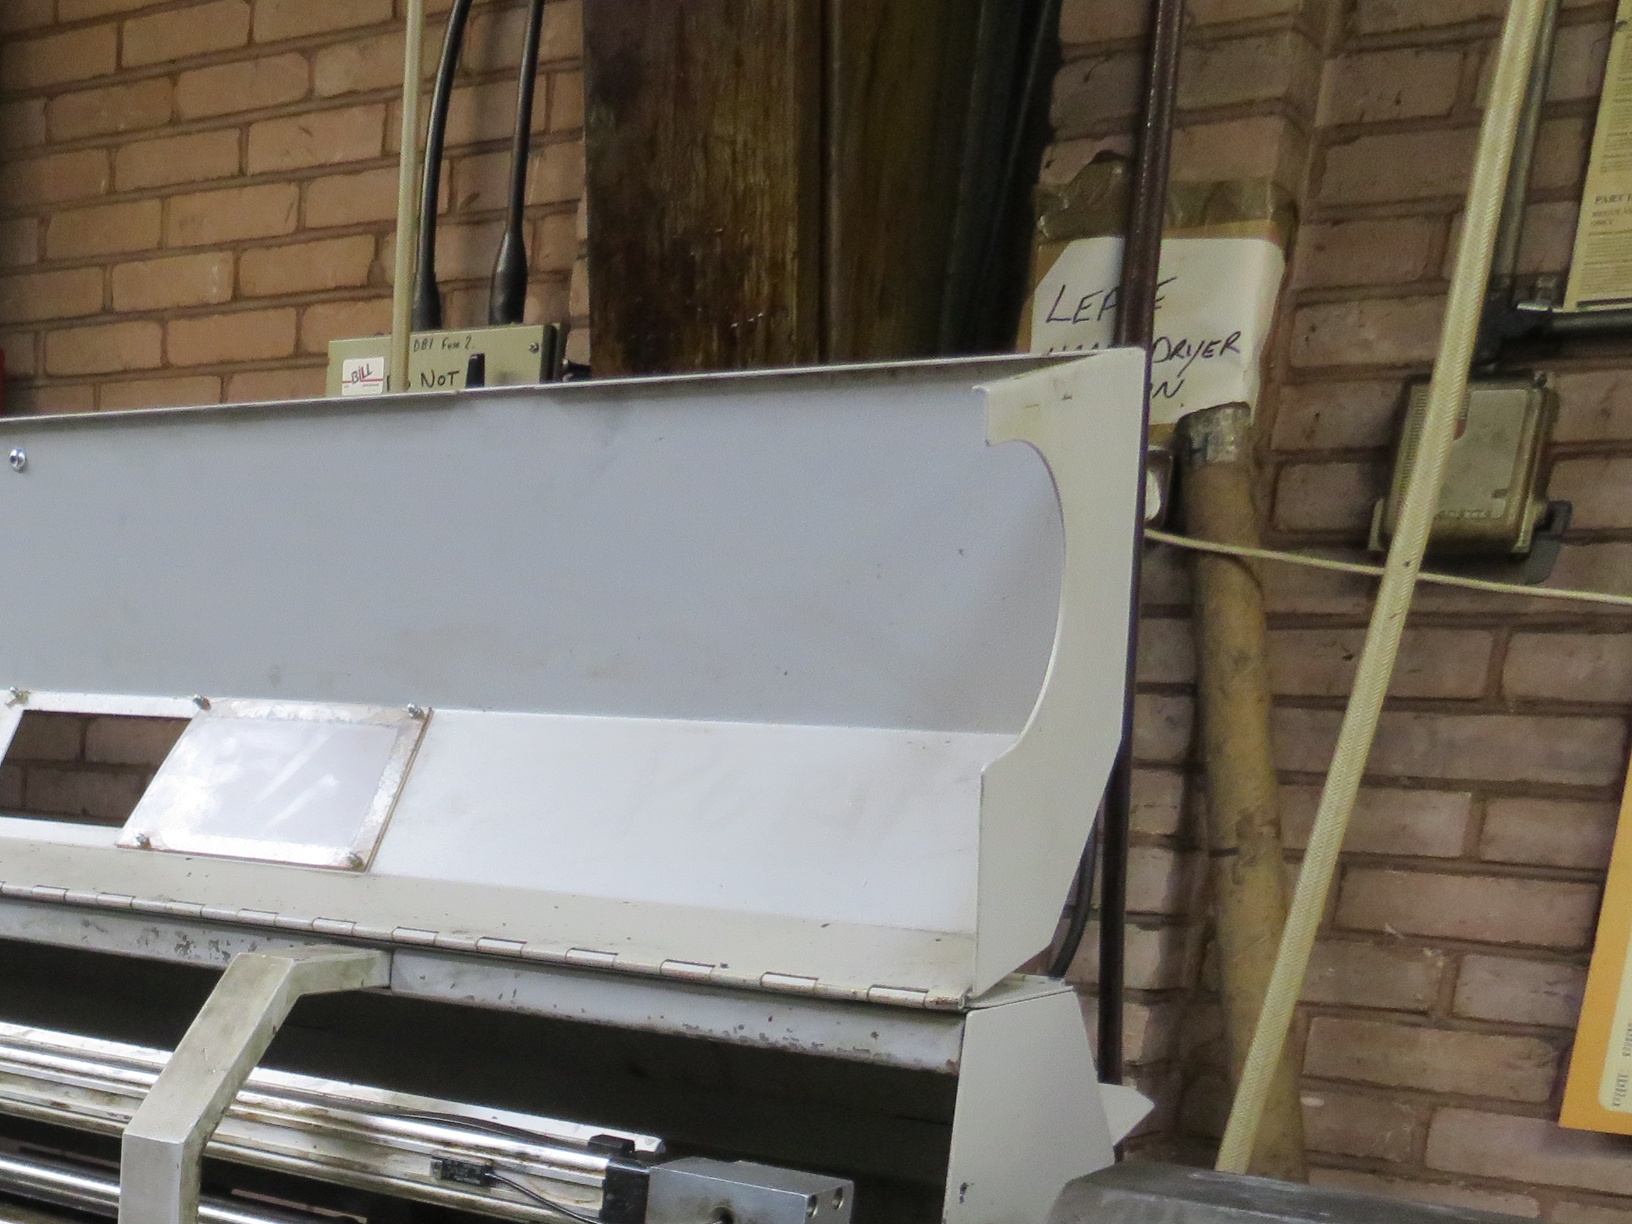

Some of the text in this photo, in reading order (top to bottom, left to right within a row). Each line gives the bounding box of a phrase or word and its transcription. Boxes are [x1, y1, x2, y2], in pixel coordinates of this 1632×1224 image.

[1045, 276, 1177, 324] LEAE
[1151, 331, 1242, 378] DRYER
[1149, 379, 1184, 399] N
